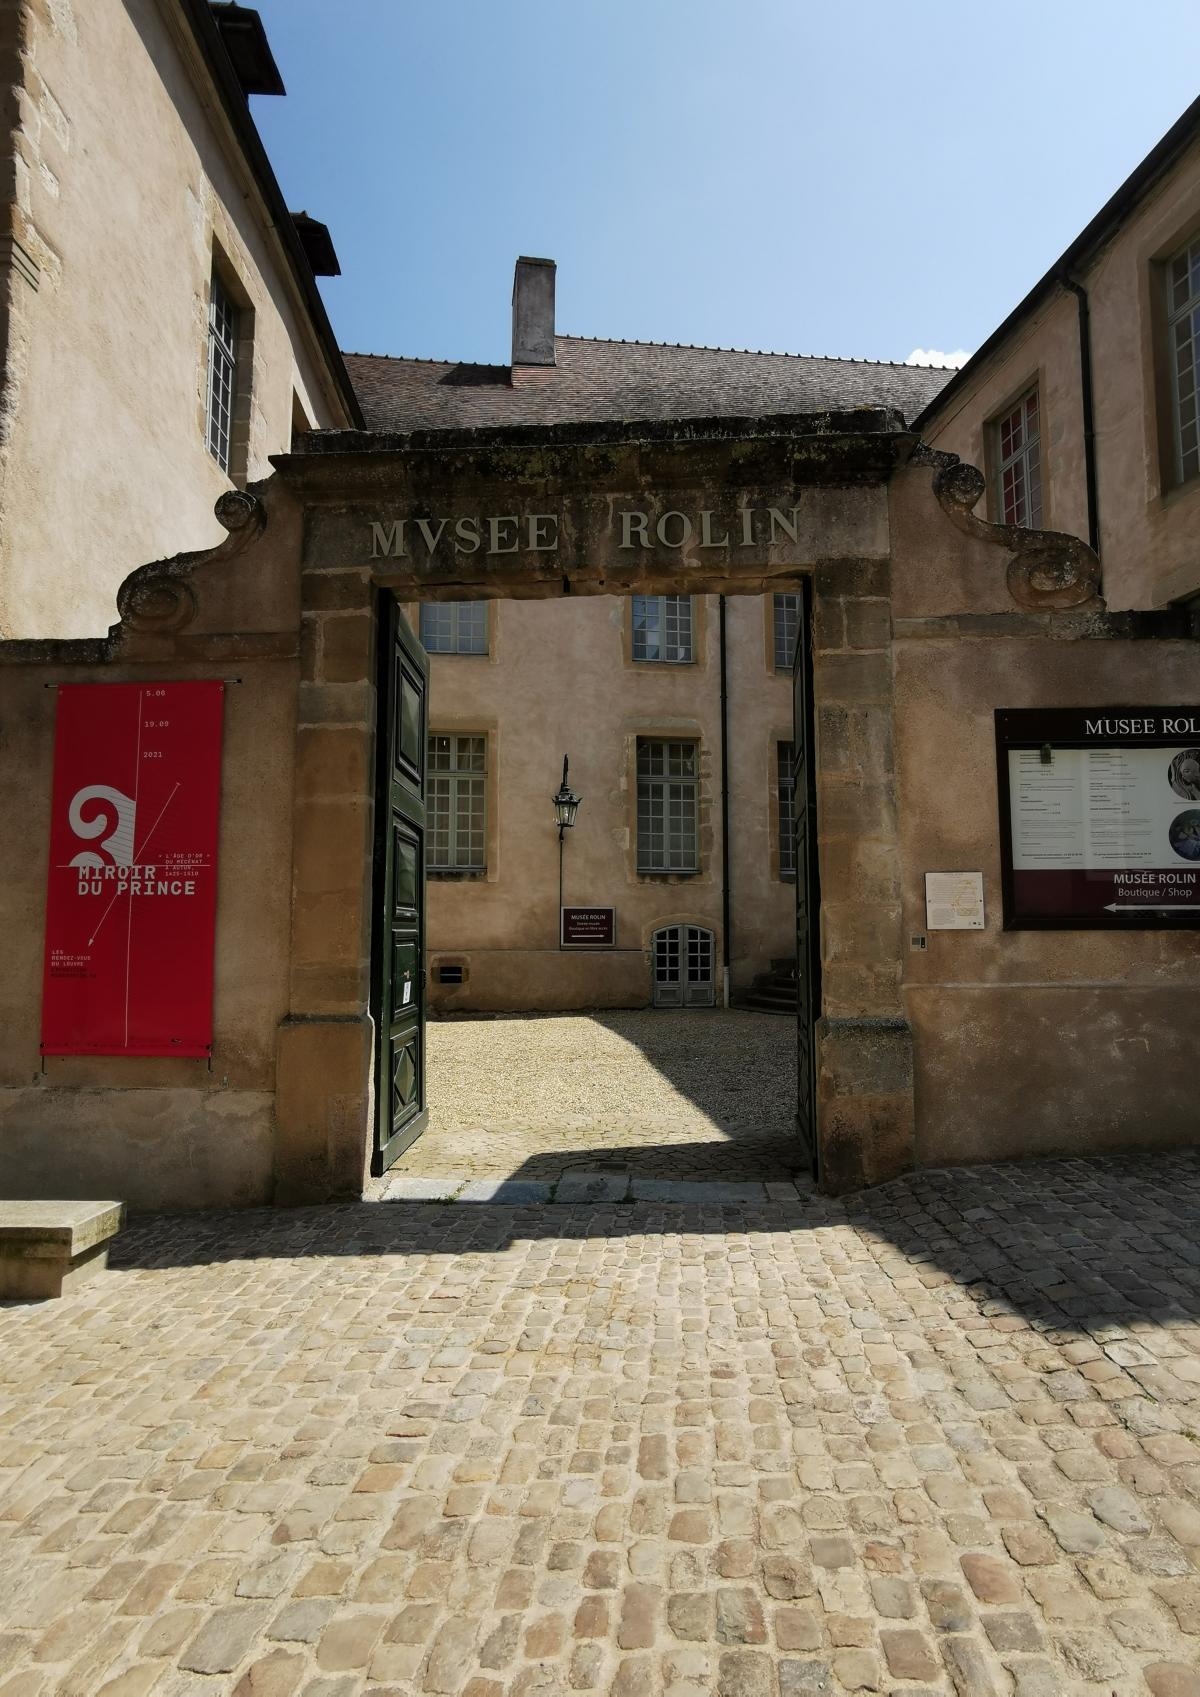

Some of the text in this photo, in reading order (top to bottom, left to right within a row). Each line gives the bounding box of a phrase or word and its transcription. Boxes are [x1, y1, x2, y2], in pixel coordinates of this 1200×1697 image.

[368, 507, 799, 558] MVSEE ROLIN
[1084, 718, 1200, 735] MUSEE ROL
[79, 866, 156, 880] MIROIR
[1113, 871, 1197, 884] MUSÉE ROLIN
[78, 881, 196, 896] DU PRINCE
[1118, 887, 1193, 899] Boutique / Shop
